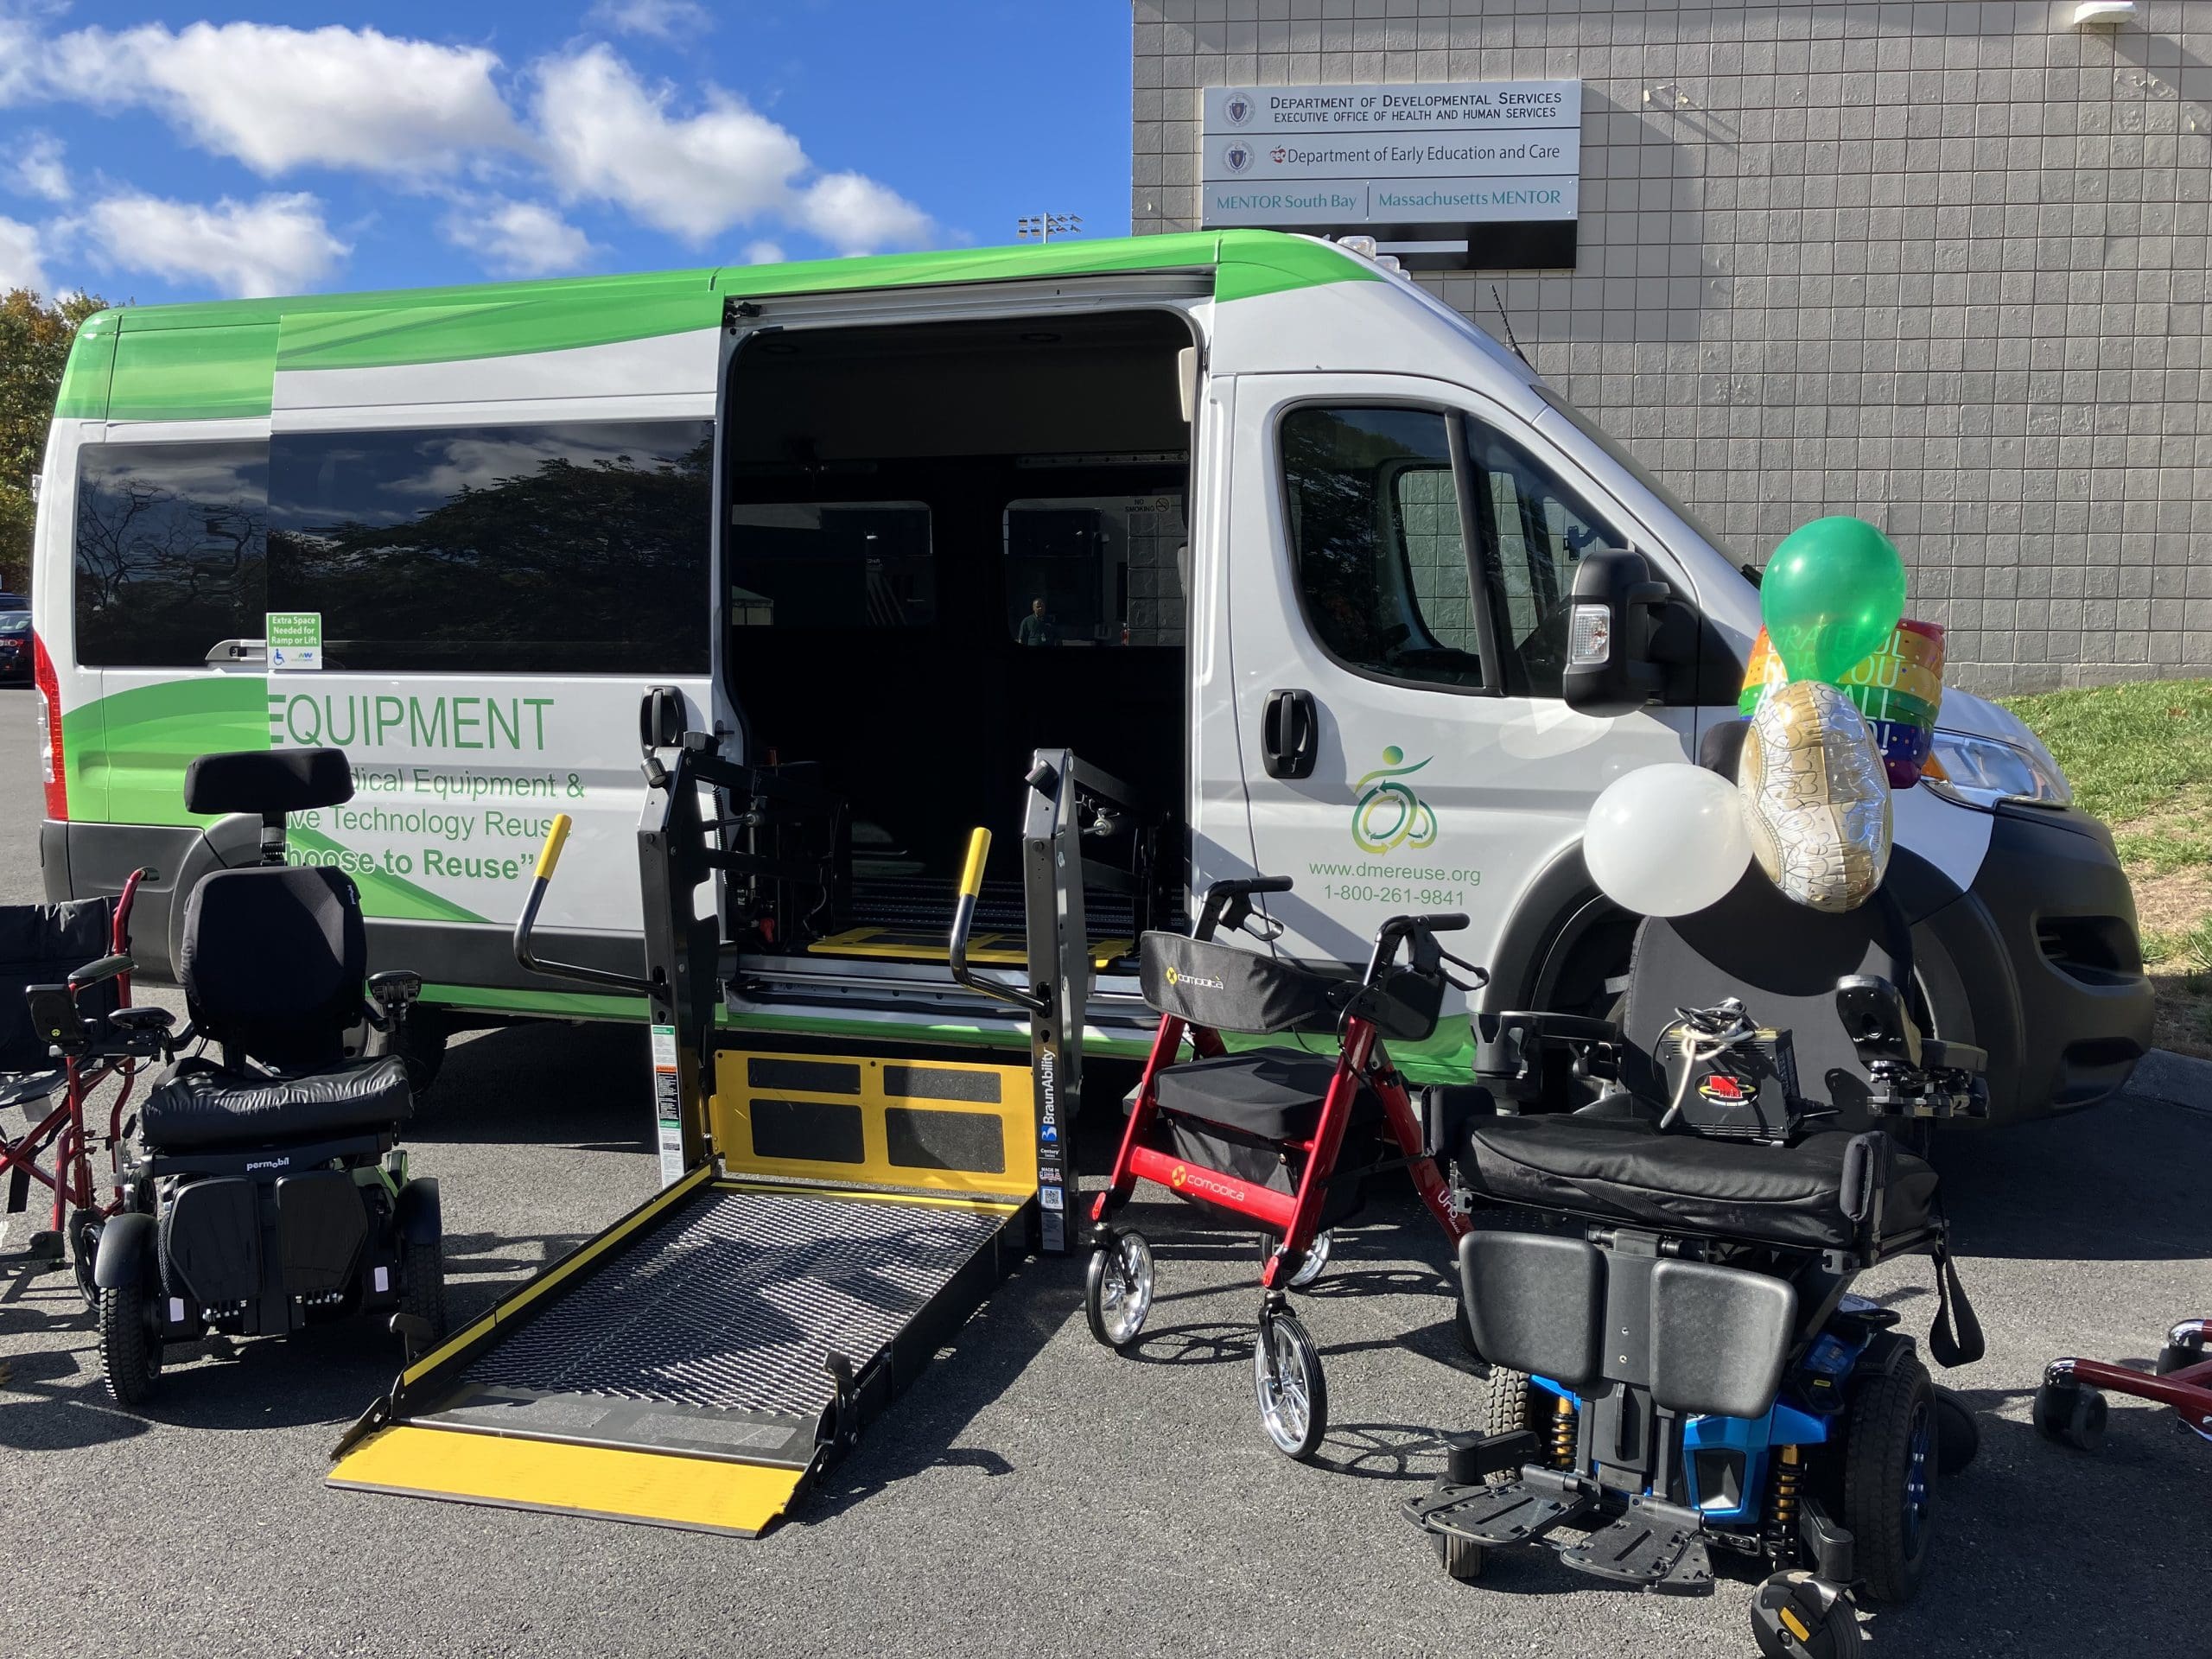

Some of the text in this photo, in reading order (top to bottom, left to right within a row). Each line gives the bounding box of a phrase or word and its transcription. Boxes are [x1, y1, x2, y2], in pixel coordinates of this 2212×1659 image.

[1360, 97, 1376, 108] OF
[1274, 107, 1556, 123] EXECUTIVE OFFICE OF HEALTH AND HUMAN SERVICES
[1287, 144, 1560, 166] Department of Early Education and Care
[1217, 194, 1357, 212] MENTOR South Bay
[1379, 189, 1561, 207] Massachusetts MENTOR
[293, 616, 315, 626] Space
[271, 636, 293, 645] Ramp
[413, 768, 556, 802] Equipment
[566, 772, 587, 798] &
[328, 804, 475, 842] Technology
[485, 810, 571, 838] Reus
[384, 849, 413, 875] to
[1309, 862, 1481, 887] www.dmereuse.org
[1324, 884, 1464, 906] 1-800-261-9841
[1041, 1046, 1056, 1125] BraunAbility
[246, 1157, 289, 1171] permobil
[1438, 1190, 1458, 1218] Uno
